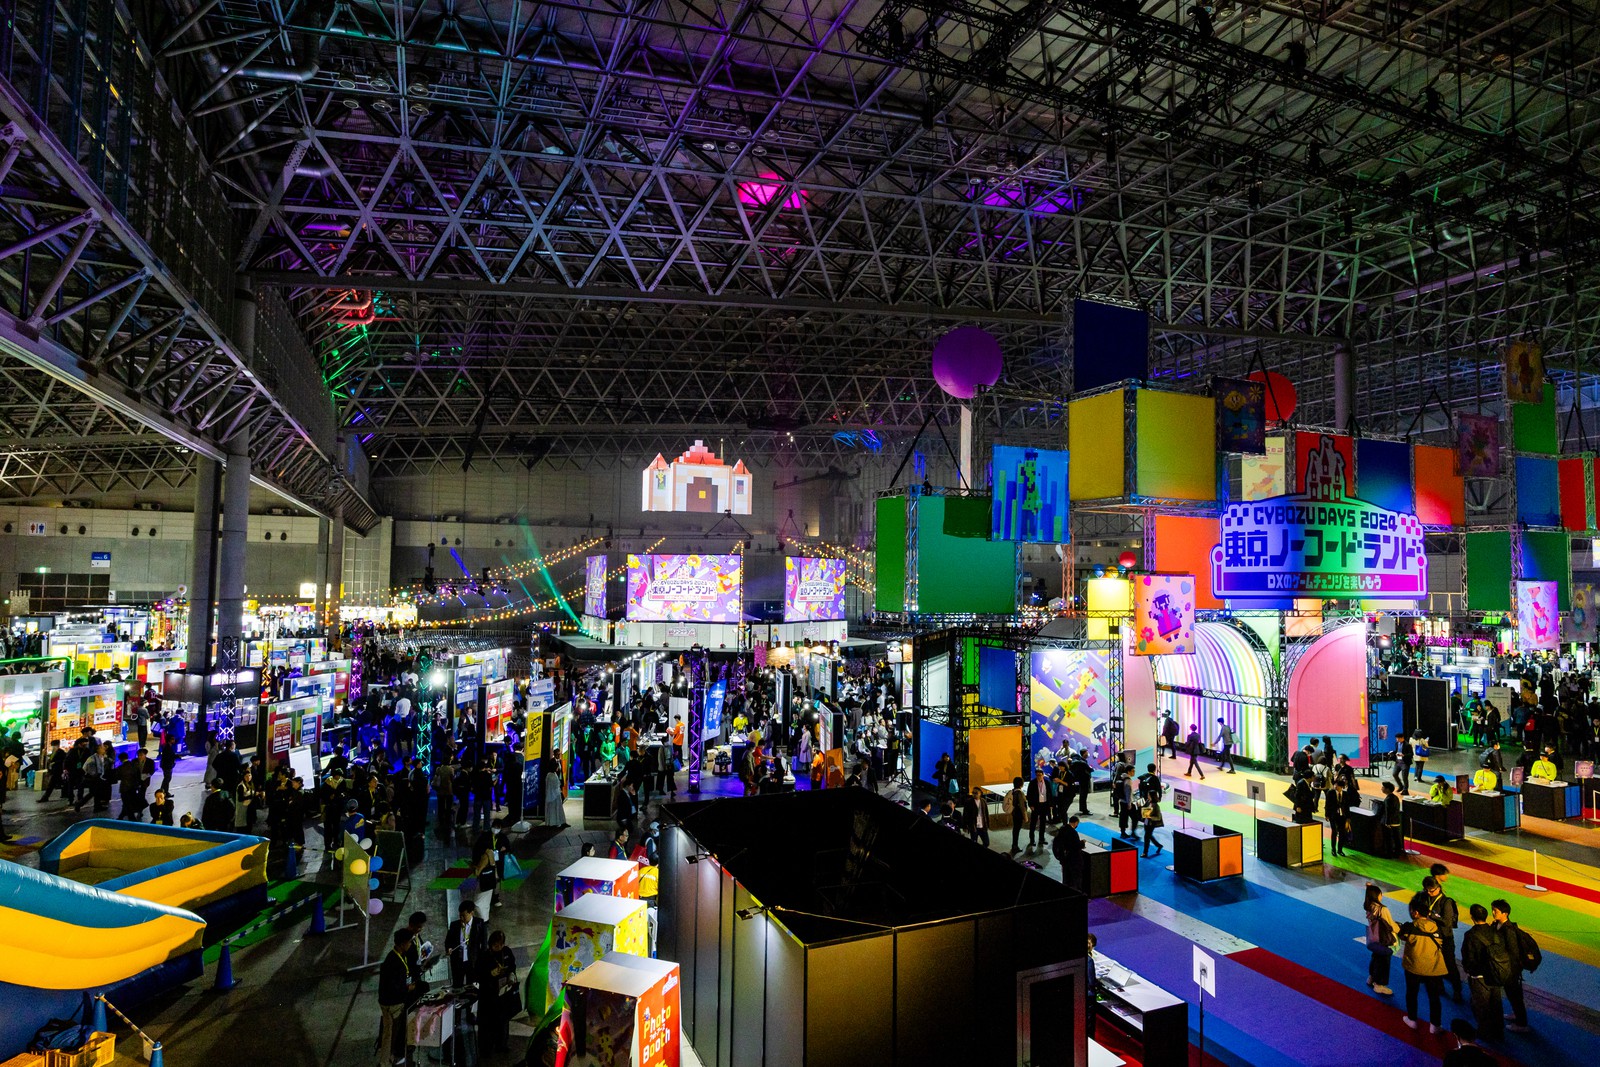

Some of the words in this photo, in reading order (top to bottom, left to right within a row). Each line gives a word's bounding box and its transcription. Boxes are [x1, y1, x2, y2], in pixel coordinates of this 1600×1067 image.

[1253, 505, 1315, 525] CYBOZU
[1318, 506, 1356, 527] DAYS
[1360, 511, 1398, 531] 2024
[1225, 529, 1421, 569] 東京ノーコードランド
[1267, 573, 1382, 590] DXのゲームチェンジを楽しもう
[643, 1005, 671, 1040] Photo
[643, 1028, 671, 1065] Booth
